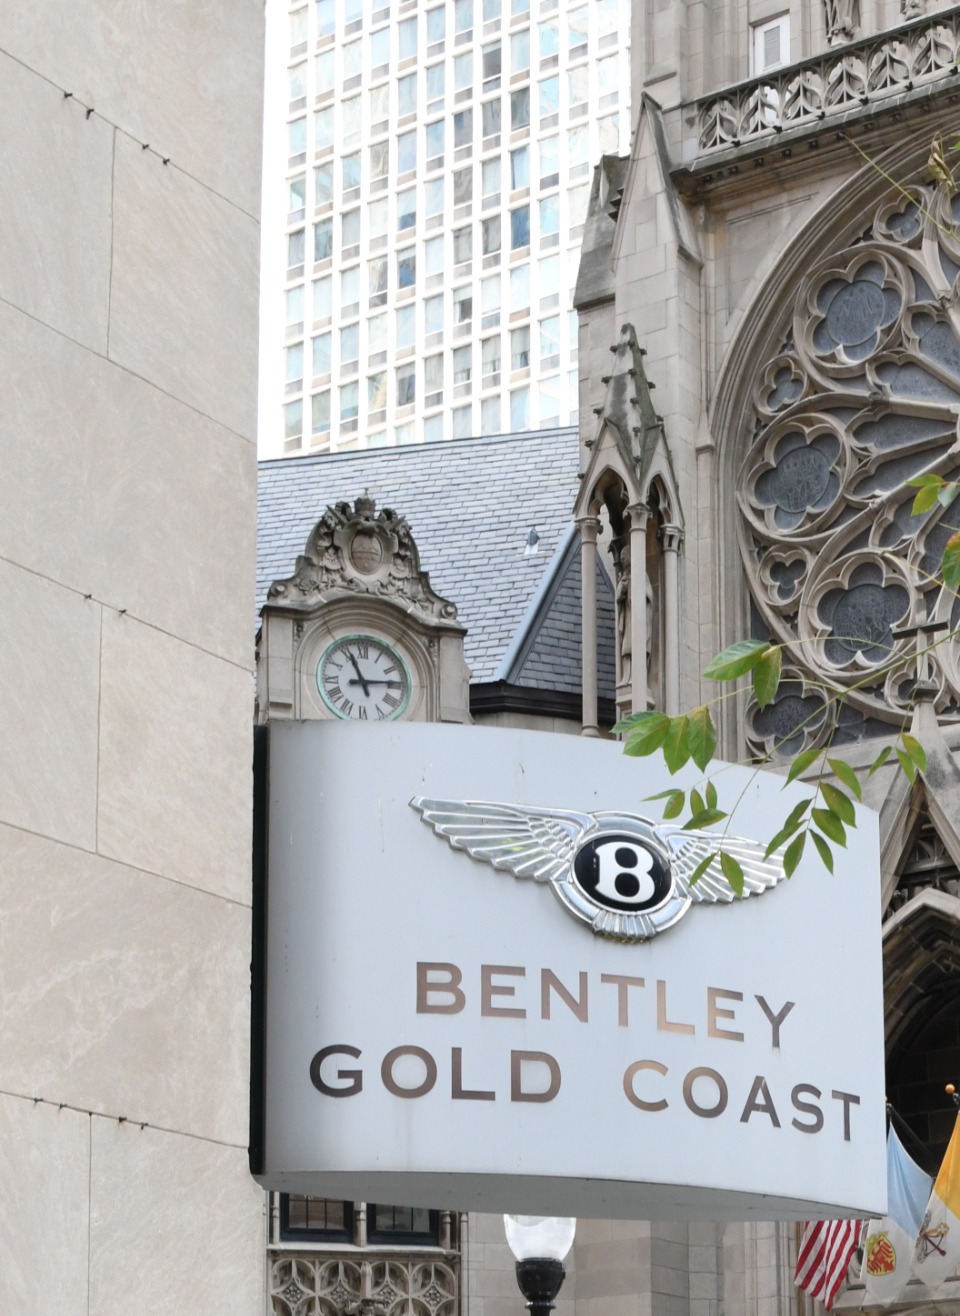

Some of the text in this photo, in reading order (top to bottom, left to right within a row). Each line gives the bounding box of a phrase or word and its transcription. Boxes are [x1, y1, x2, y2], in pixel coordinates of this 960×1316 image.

[594, 841, 655, 904] B
[416, 961, 796, 1049] BENTLEY
[309, 1044, 861, 1142] GOLD COAST
